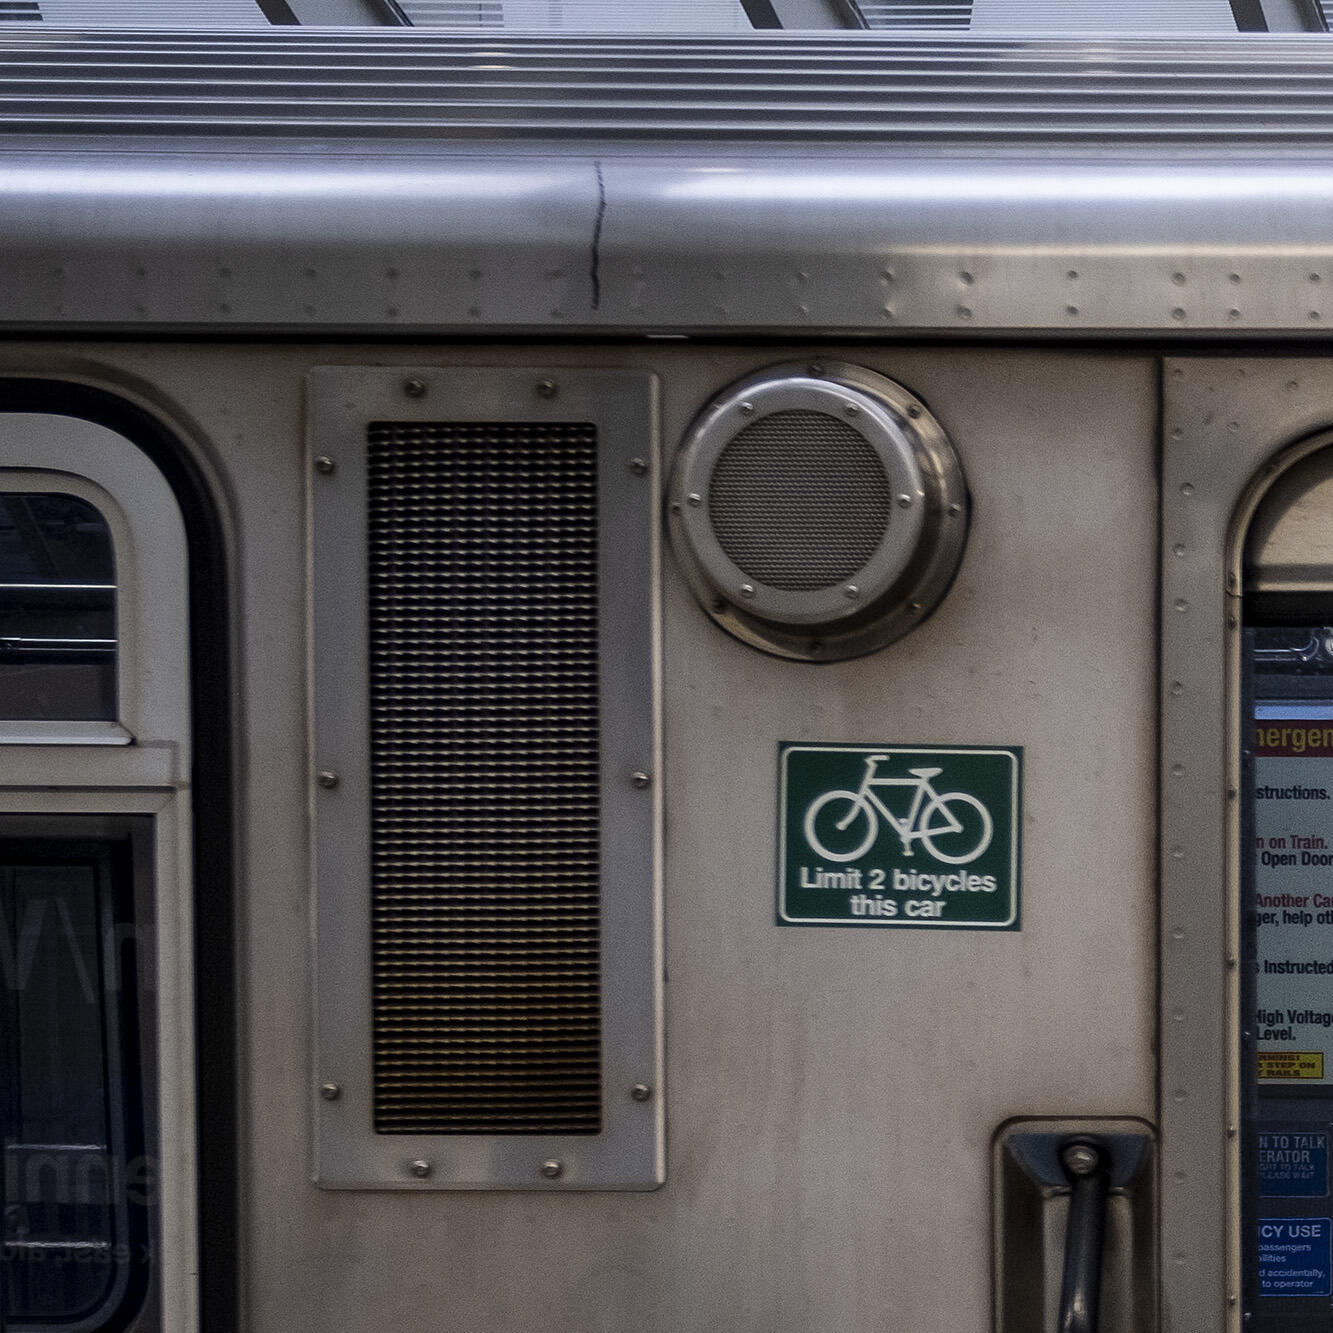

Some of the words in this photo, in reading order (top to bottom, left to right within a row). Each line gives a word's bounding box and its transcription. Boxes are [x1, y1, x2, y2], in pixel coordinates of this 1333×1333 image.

[1256, 786, 1331, 800] structions.
[1269, 837, 1286, 849] on
[1290, 834, 1328, 849] Train.
[1262, 851, 1296, 868] Open
[800, 866, 863, 889] Limit
[868, 868, 886, 890] 2
[892, 868, 998, 897] bicycles
[850, 894, 899, 916] this
[904, 898, 948, 917] car
[1256, 894, 1310, 907] Another
[1283, 910, 1312, 927] help
[1256, 1027, 1296, 1041] Level.
[1272, 1136, 1289, 1149] TO
[1293, 1136, 1325, 1149] TALK
[1259, 1150, 1310, 1163] ERATOR
[1258, 1225, 1284, 1238] CY
[1288, 1224, 1321, 1238] USE
[1267, 1269, 1326, 1279] accidentally,
[1273, 1281, 1313, 1289] operator
